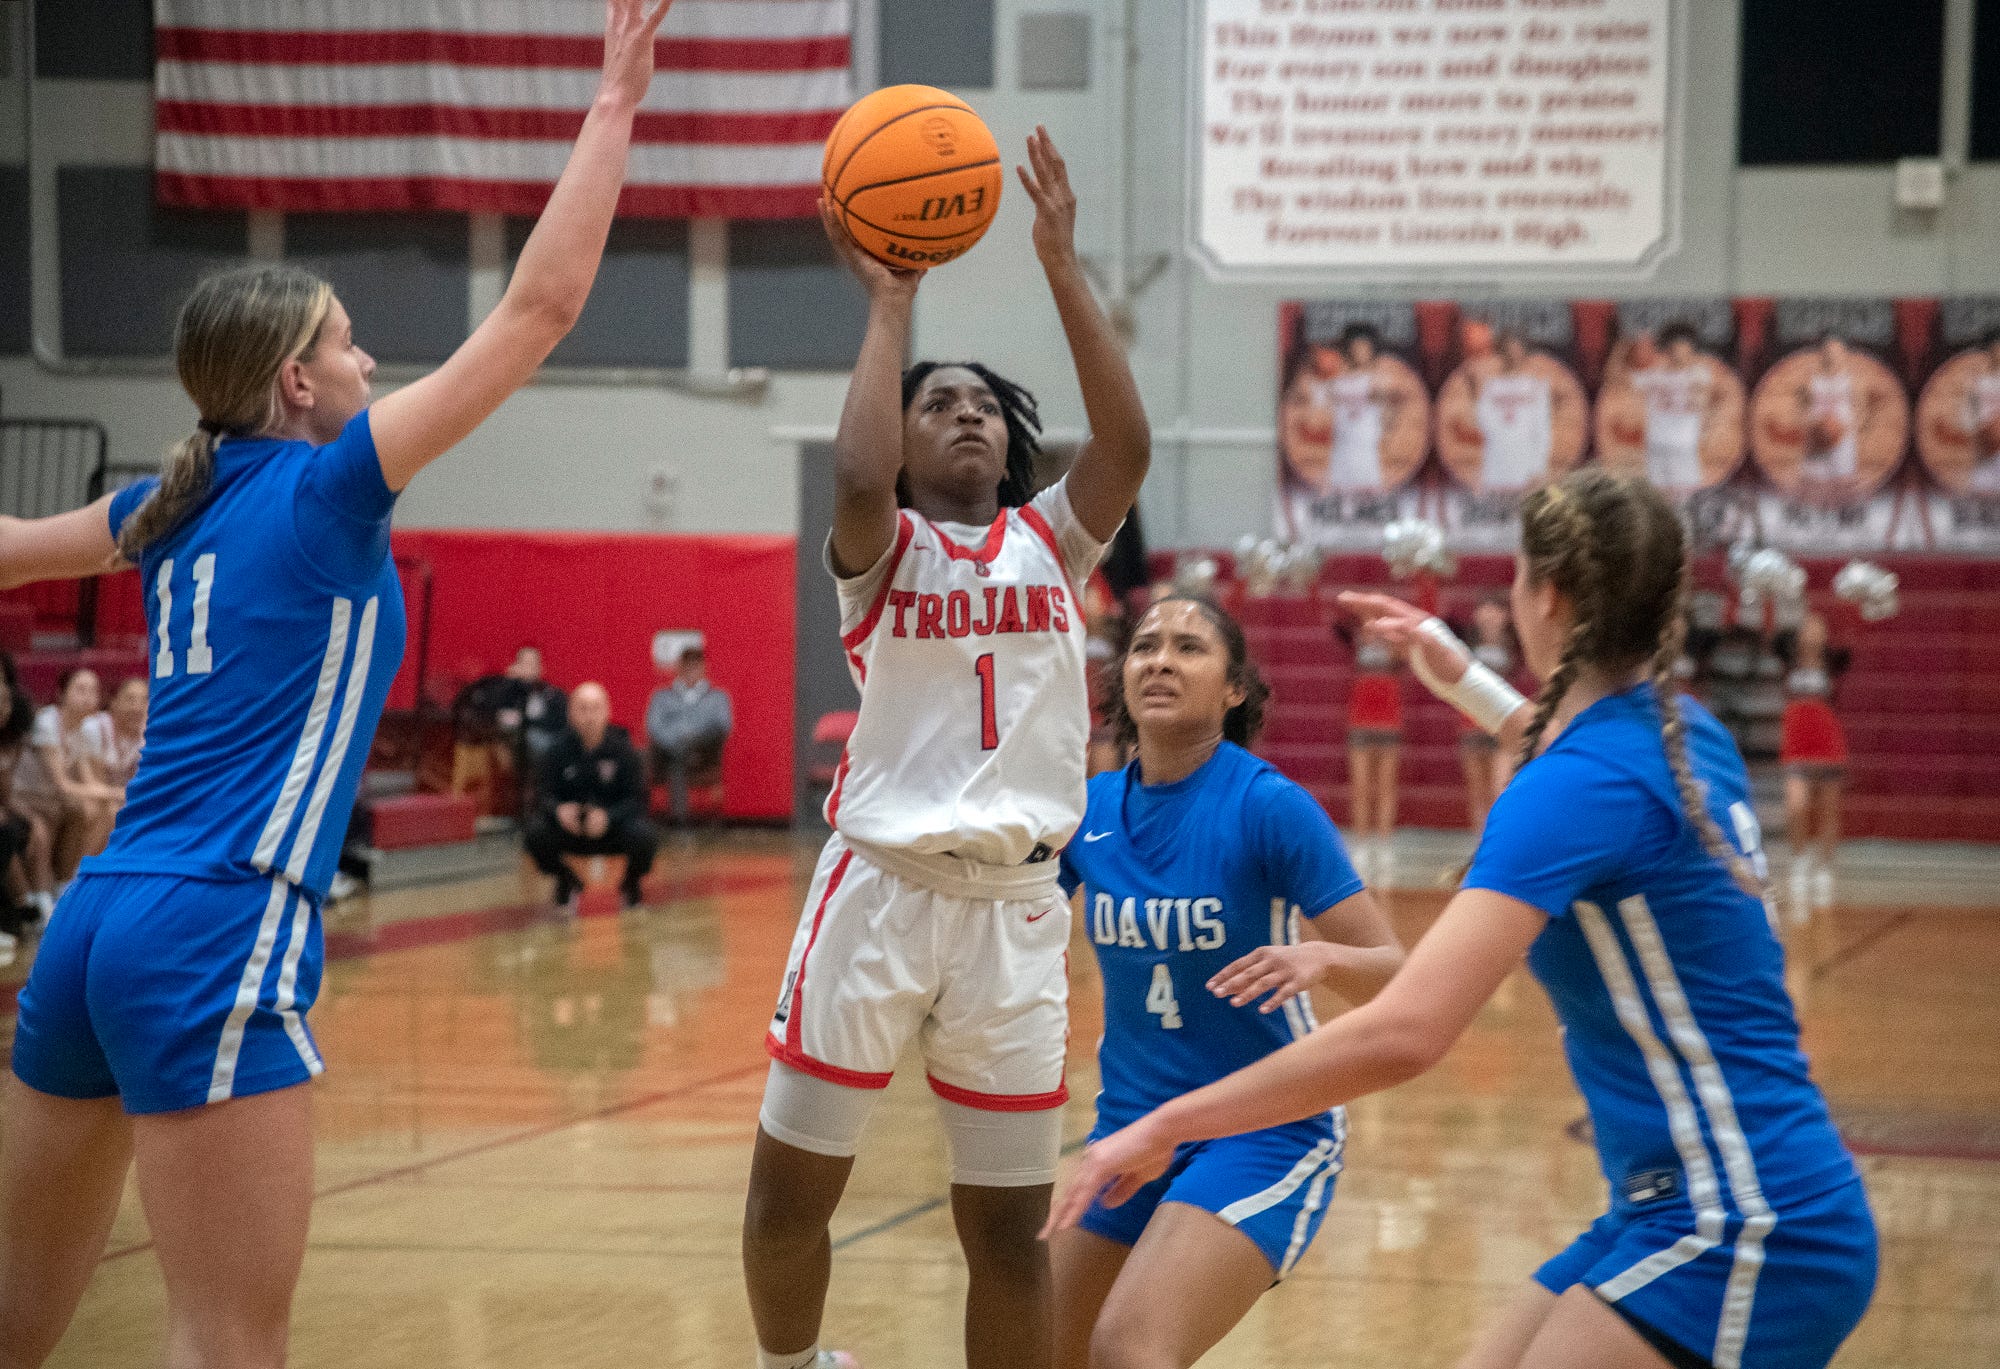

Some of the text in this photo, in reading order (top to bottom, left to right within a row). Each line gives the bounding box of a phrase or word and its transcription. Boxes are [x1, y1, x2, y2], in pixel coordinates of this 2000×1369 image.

[918, 187, 985, 222] EVO
[155, 553, 217, 679] 11
[889, 585, 1070, 639] TROJANS
[975, 652, 999, 751] 1
[1094, 892, 1227, 952] DAVIS
[1145, 963, 1184, 1030] 4
